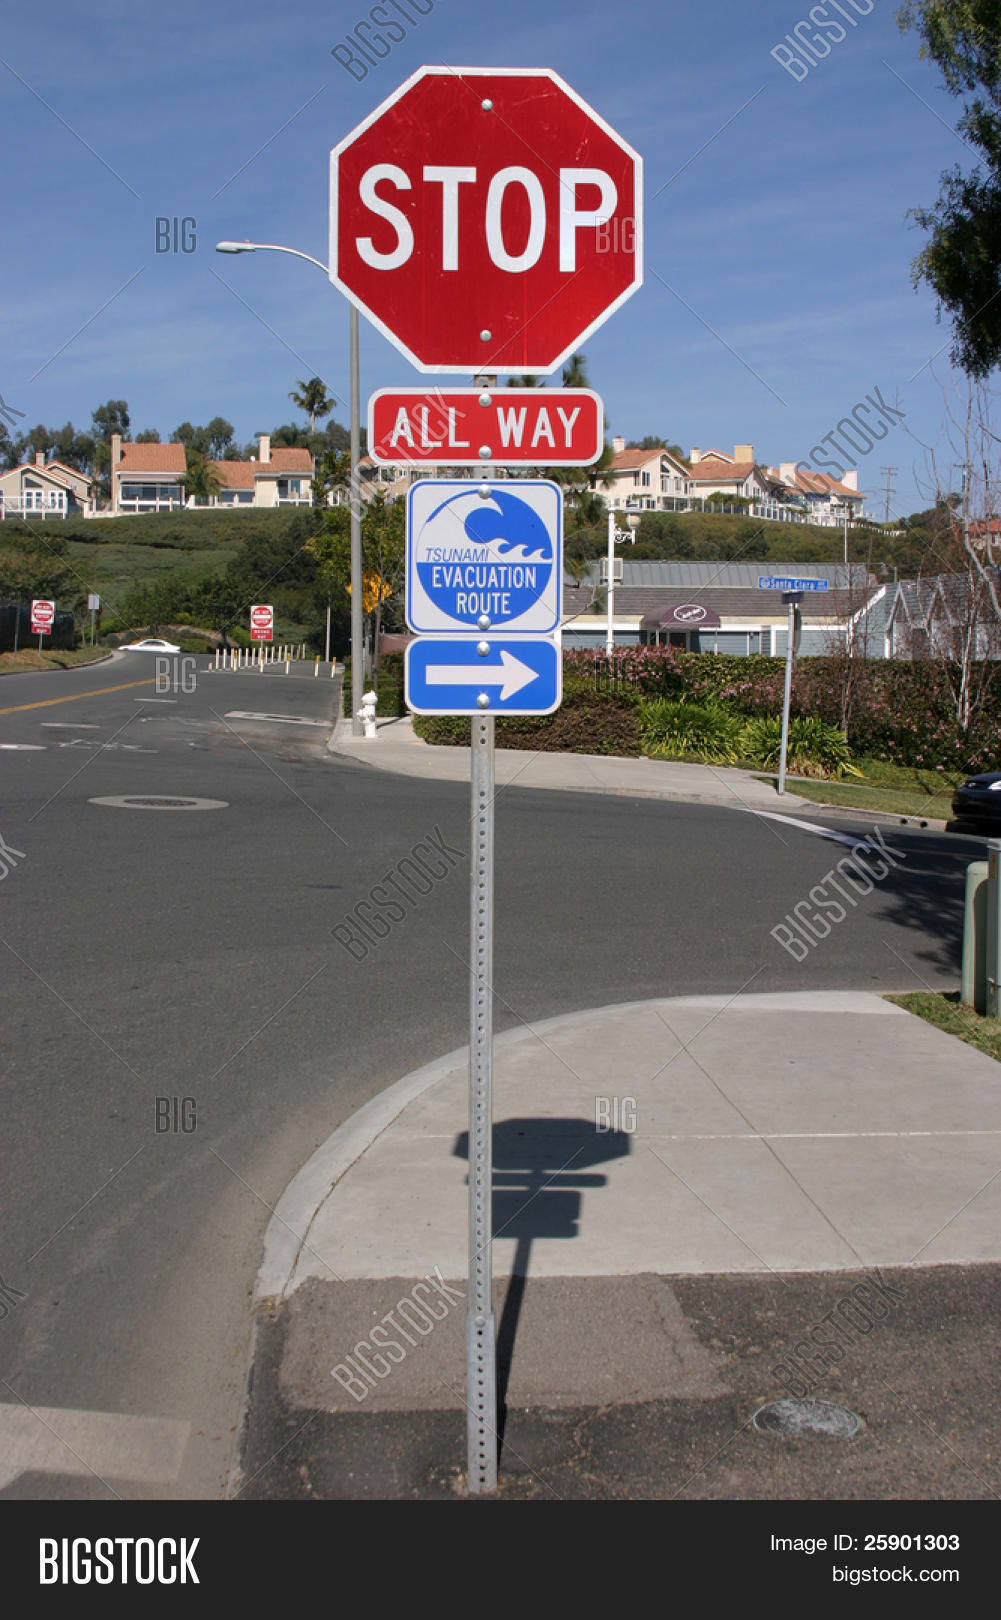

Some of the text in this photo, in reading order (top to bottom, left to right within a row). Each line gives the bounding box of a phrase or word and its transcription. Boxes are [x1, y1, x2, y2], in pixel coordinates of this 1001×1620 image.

[356, 163, 618, 273] STOP
[390, 407, 582, 448] ALL WAY
[425, 547, 490, 562] TSUNAMI
[432, 566, 537, 589] EVACUATION
[456, 592, 512, 615] ROUTE
